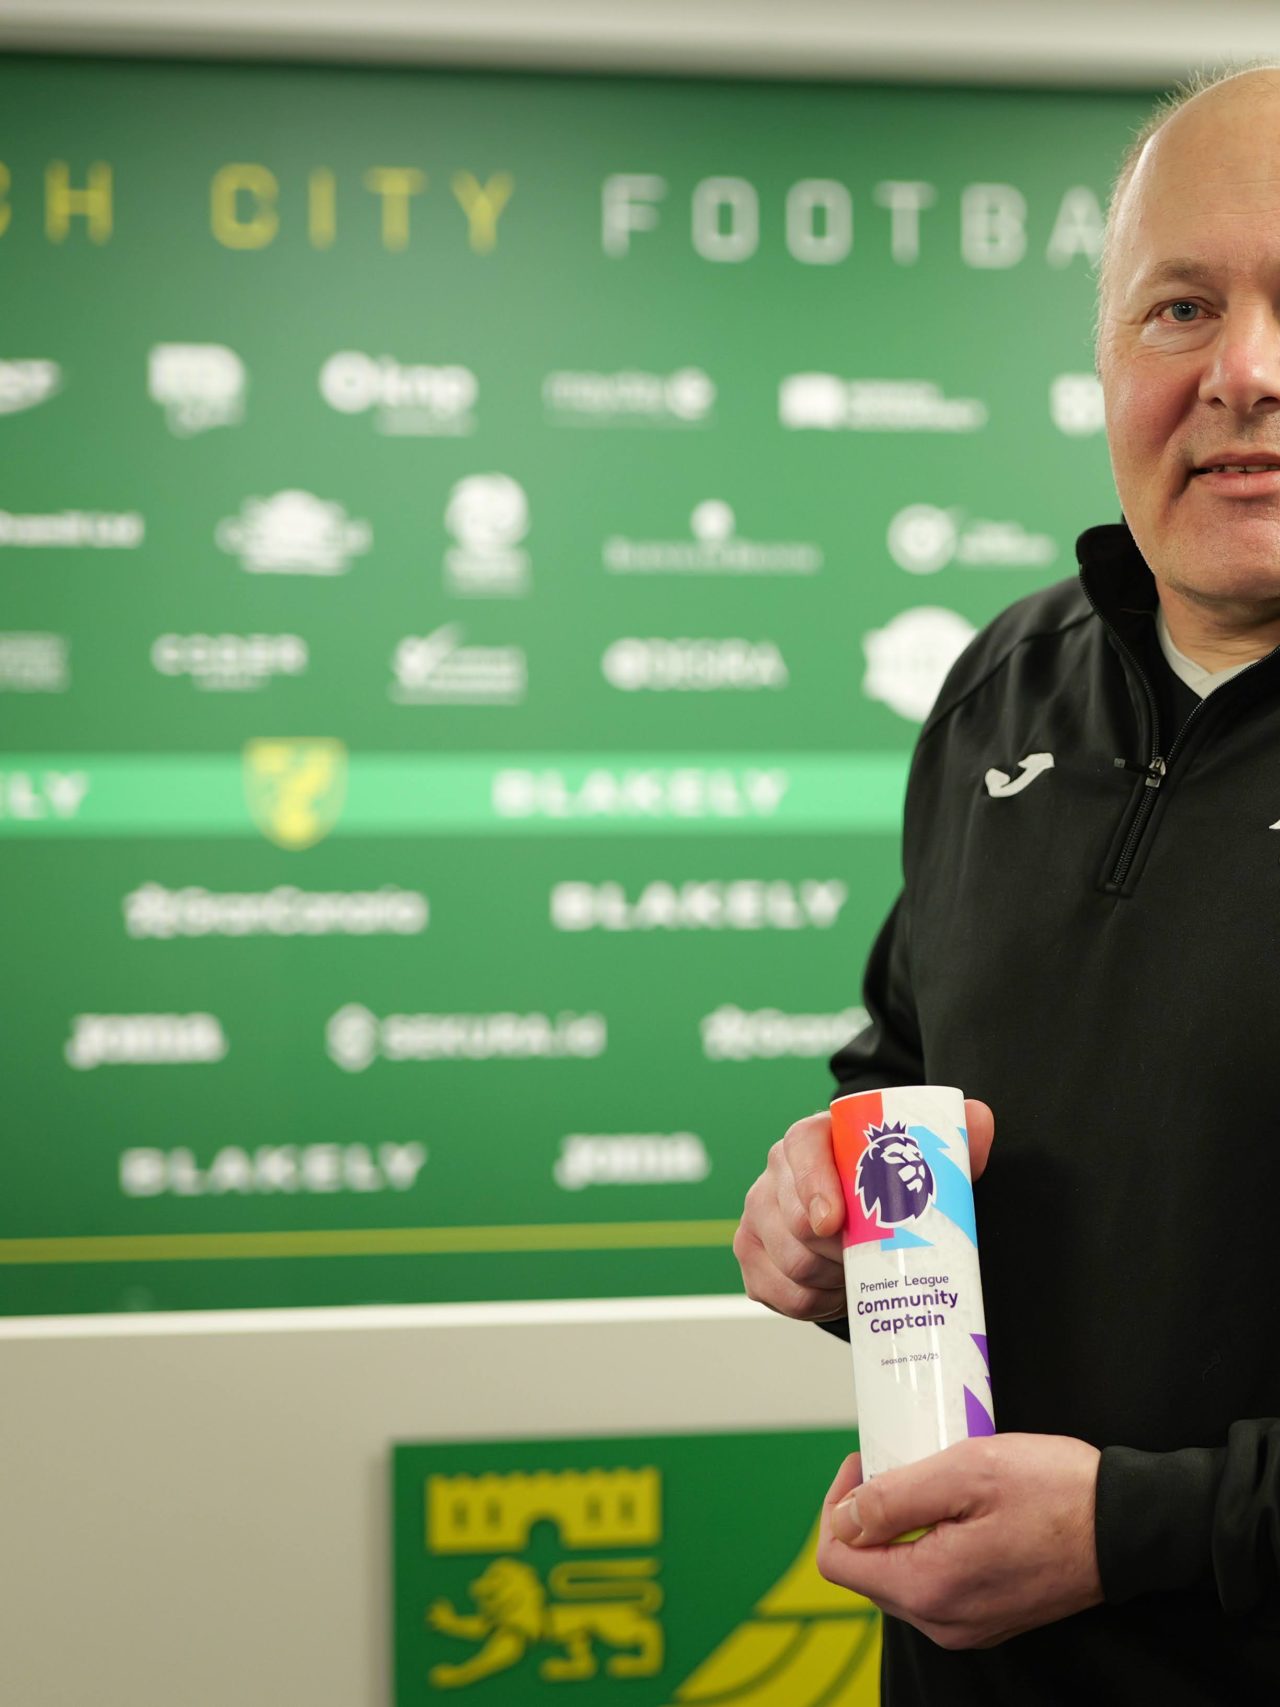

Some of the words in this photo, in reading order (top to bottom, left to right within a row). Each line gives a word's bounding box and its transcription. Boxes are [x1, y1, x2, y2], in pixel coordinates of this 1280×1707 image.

[211, 163, 514, 256] CITY
[603, 174, 1108, 268] FOOTBA
[492, 768, 790, 818] BLAKELY
[550, 880, 848, 931] BLAKELY
[119, 1141, 427, 1197] BLAKELY
[857, 1289, 958, 1315] Community
[860, 1278, 899, 1293] Premier
[904, 1275, 949, 1287] League
[870, 1310, 945, 1334] Captain
[881, 1356, 908, 1366] Season
